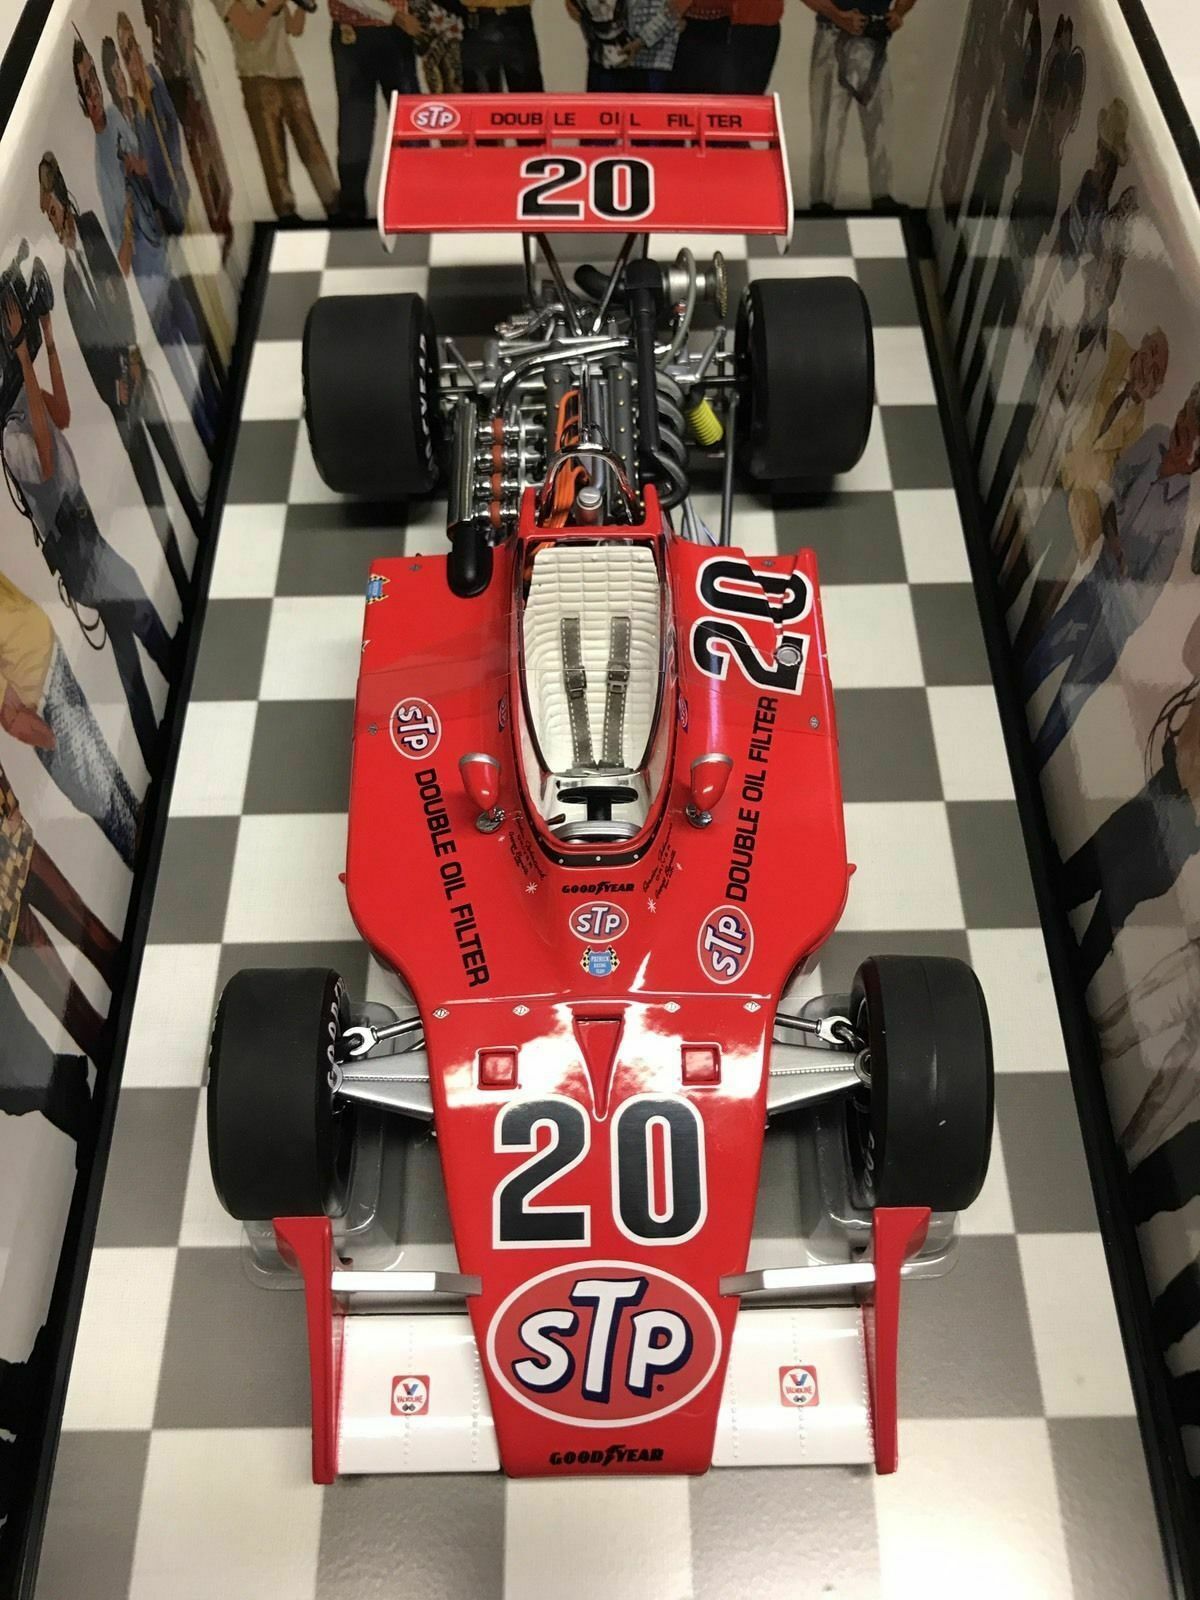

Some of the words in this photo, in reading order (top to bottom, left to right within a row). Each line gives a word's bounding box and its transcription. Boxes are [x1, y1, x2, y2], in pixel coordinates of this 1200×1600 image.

[416, 106, 454, 128] STP
[517, 155, 655, 221] 20
[690, 556, 813, 696] 20
[397, 705, 437, 751] STP
[748, 696, 778, 763] FILTER
[415, 768, 456, 857] DOUBLE
[742, 770, 766, 802] OIL
[440, 861, 466, 900] OIL
[726, 808, 759, 902] DOUBLE
[562, 881, 635, 895] GOODYEAR
[450, 903, 490, 987] FILTER
[576, 906, 622, 936] STP
[704, 914, 746, 977] STP
[492, 1092, 708, 1249] 20
[511, 1277, 694, 1404] STP
[549, 1444, 664, 1467] GOODYEAR
